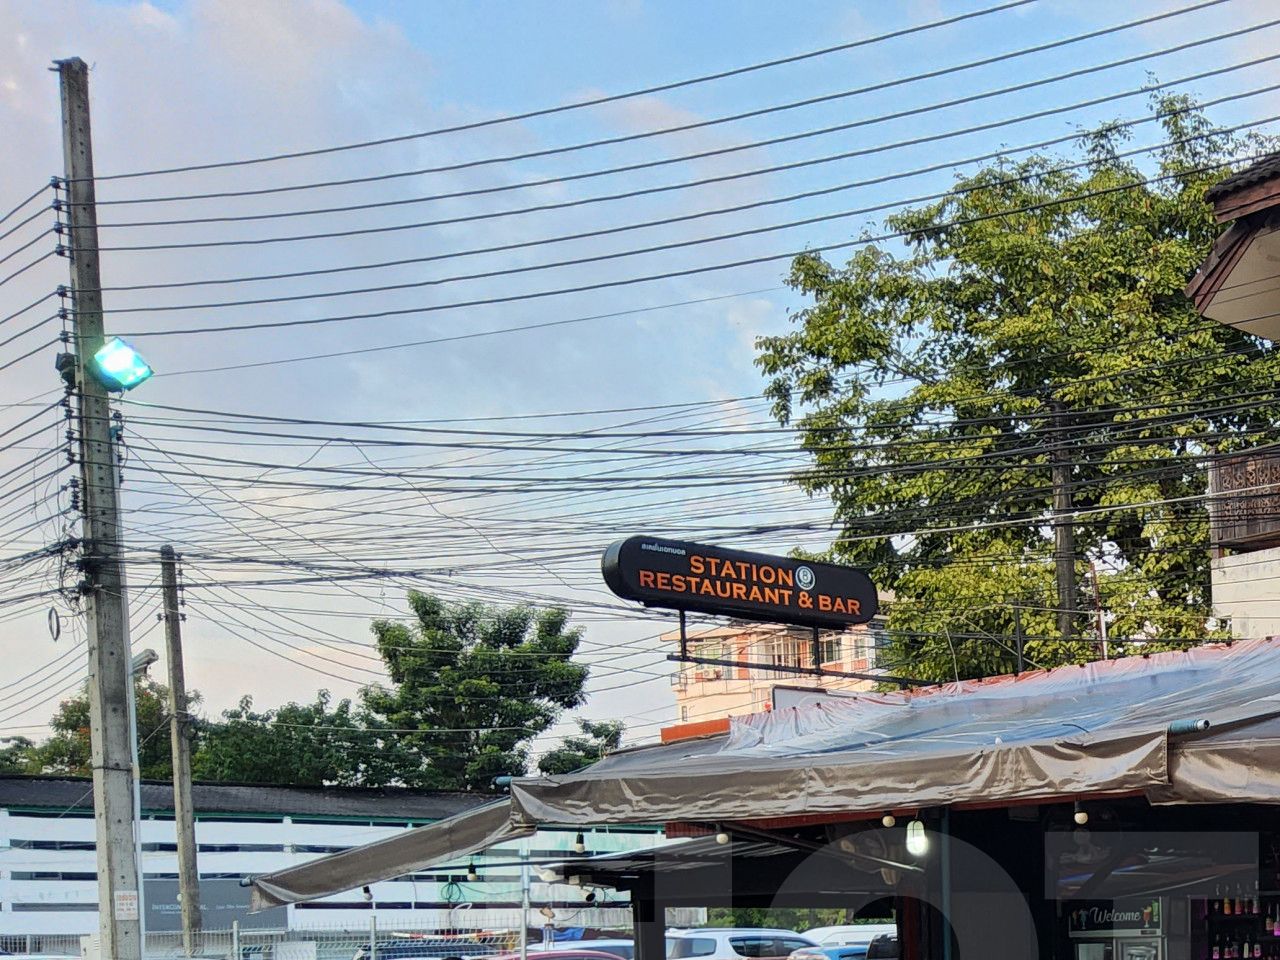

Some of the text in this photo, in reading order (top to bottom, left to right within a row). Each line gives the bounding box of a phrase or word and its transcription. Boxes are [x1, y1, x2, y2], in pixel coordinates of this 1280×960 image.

[690, 555, 794, 587] STATION
[639, 569, 861, 616] RESTAURANT & BAR
[1089, 906, 1141, 924] Welcome
